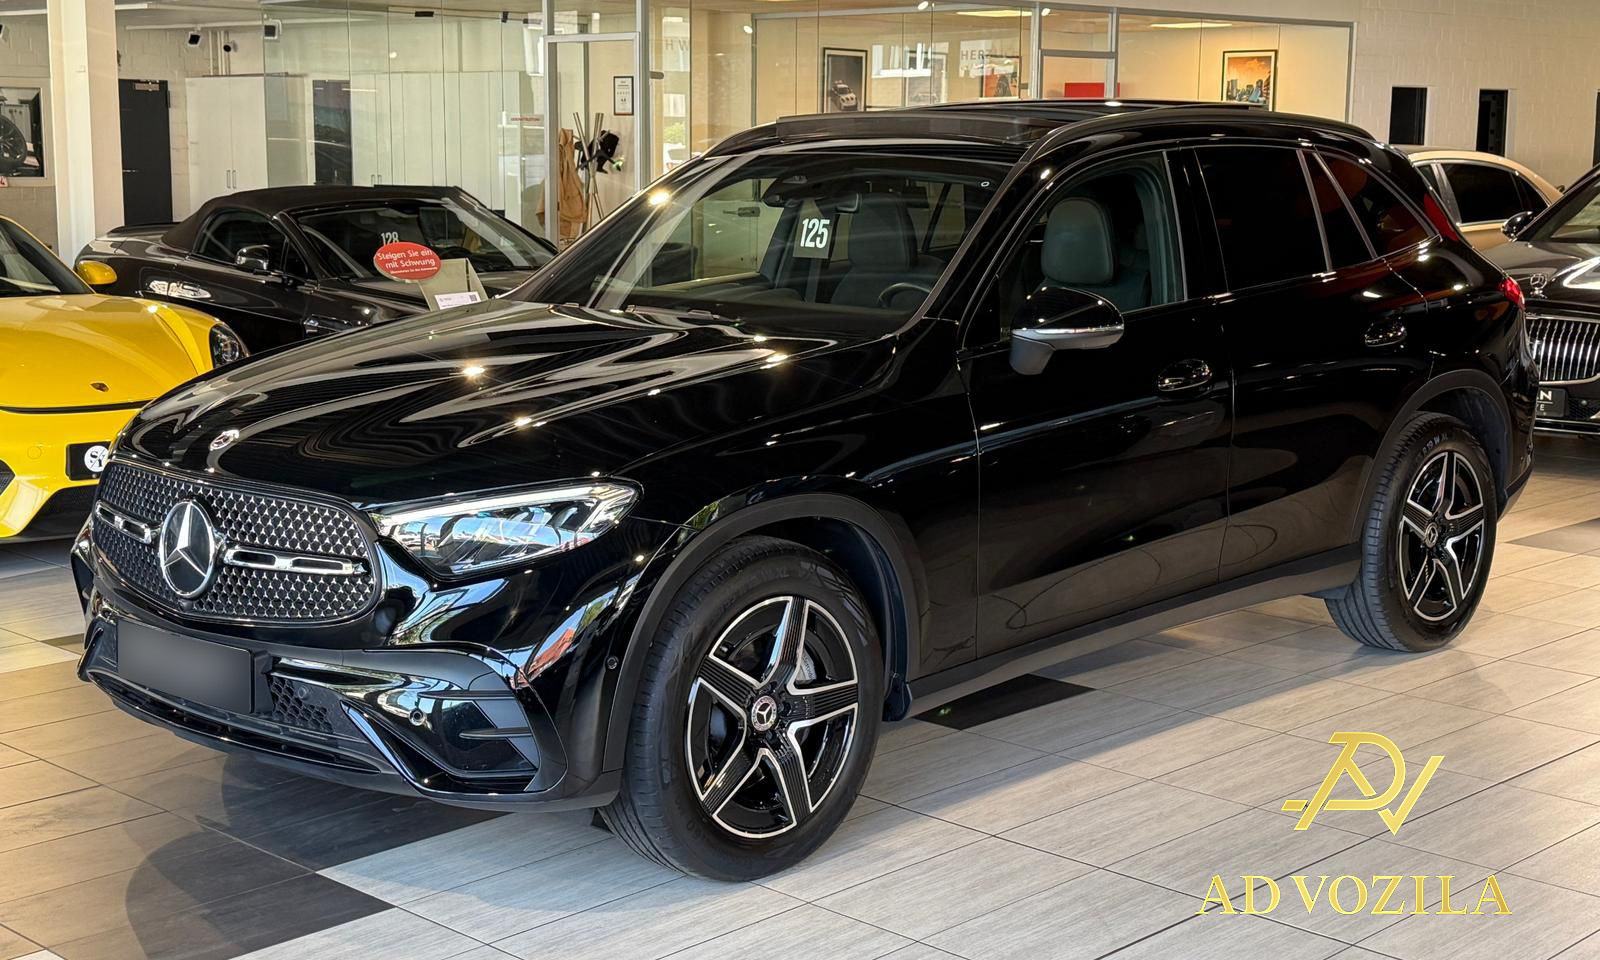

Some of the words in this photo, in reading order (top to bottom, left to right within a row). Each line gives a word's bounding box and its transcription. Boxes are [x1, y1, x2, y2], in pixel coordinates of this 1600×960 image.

[800, 218, 830, 248] 125
[377, 252, 406, 260] Steigen
[407, 249, 419, 258] Sie
[420, 248, 433, 257] ein
[385, 260, 398, 269] mit
[400, 259, 435, 267] Schwung
